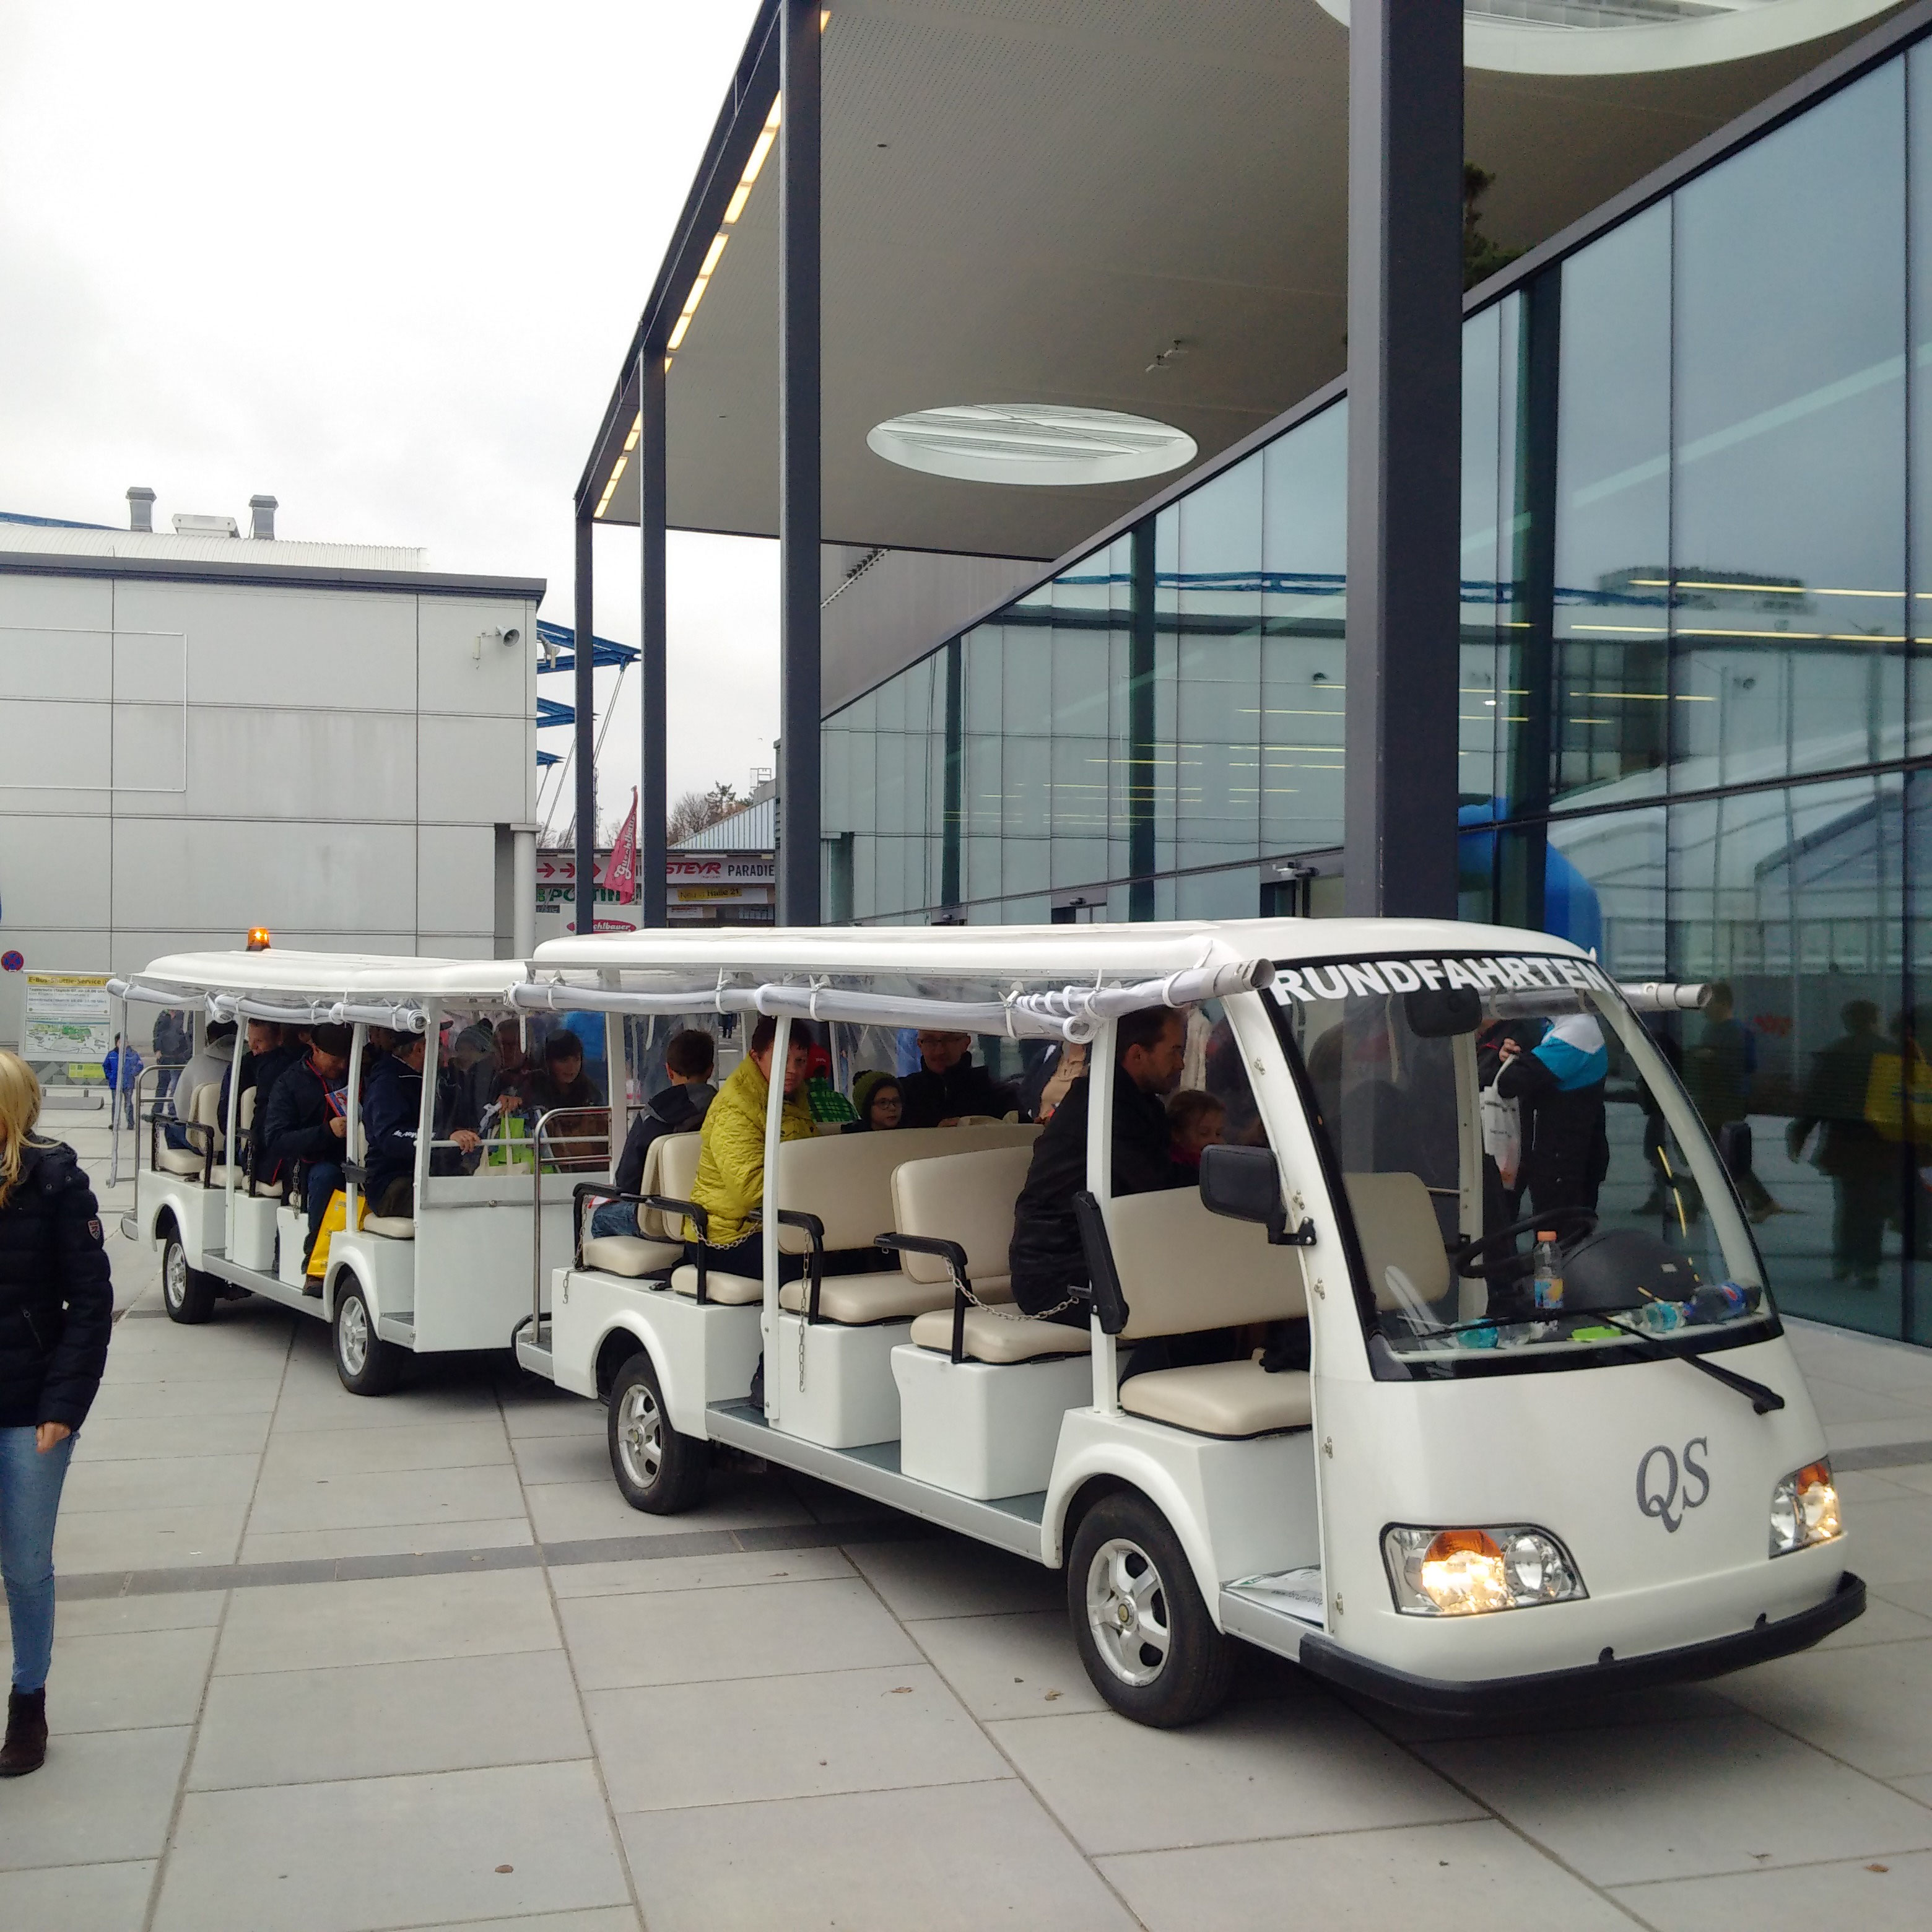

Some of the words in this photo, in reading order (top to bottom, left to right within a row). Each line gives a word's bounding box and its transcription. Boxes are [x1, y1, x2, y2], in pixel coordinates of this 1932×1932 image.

[666, 862, 721, 874] STEYR
[593, 922, 631, 930] chlbauer
[1273, 957, 1611, 1007] RUNDFAHRTEN
[1636, 1436, 1710, 1533] QS
